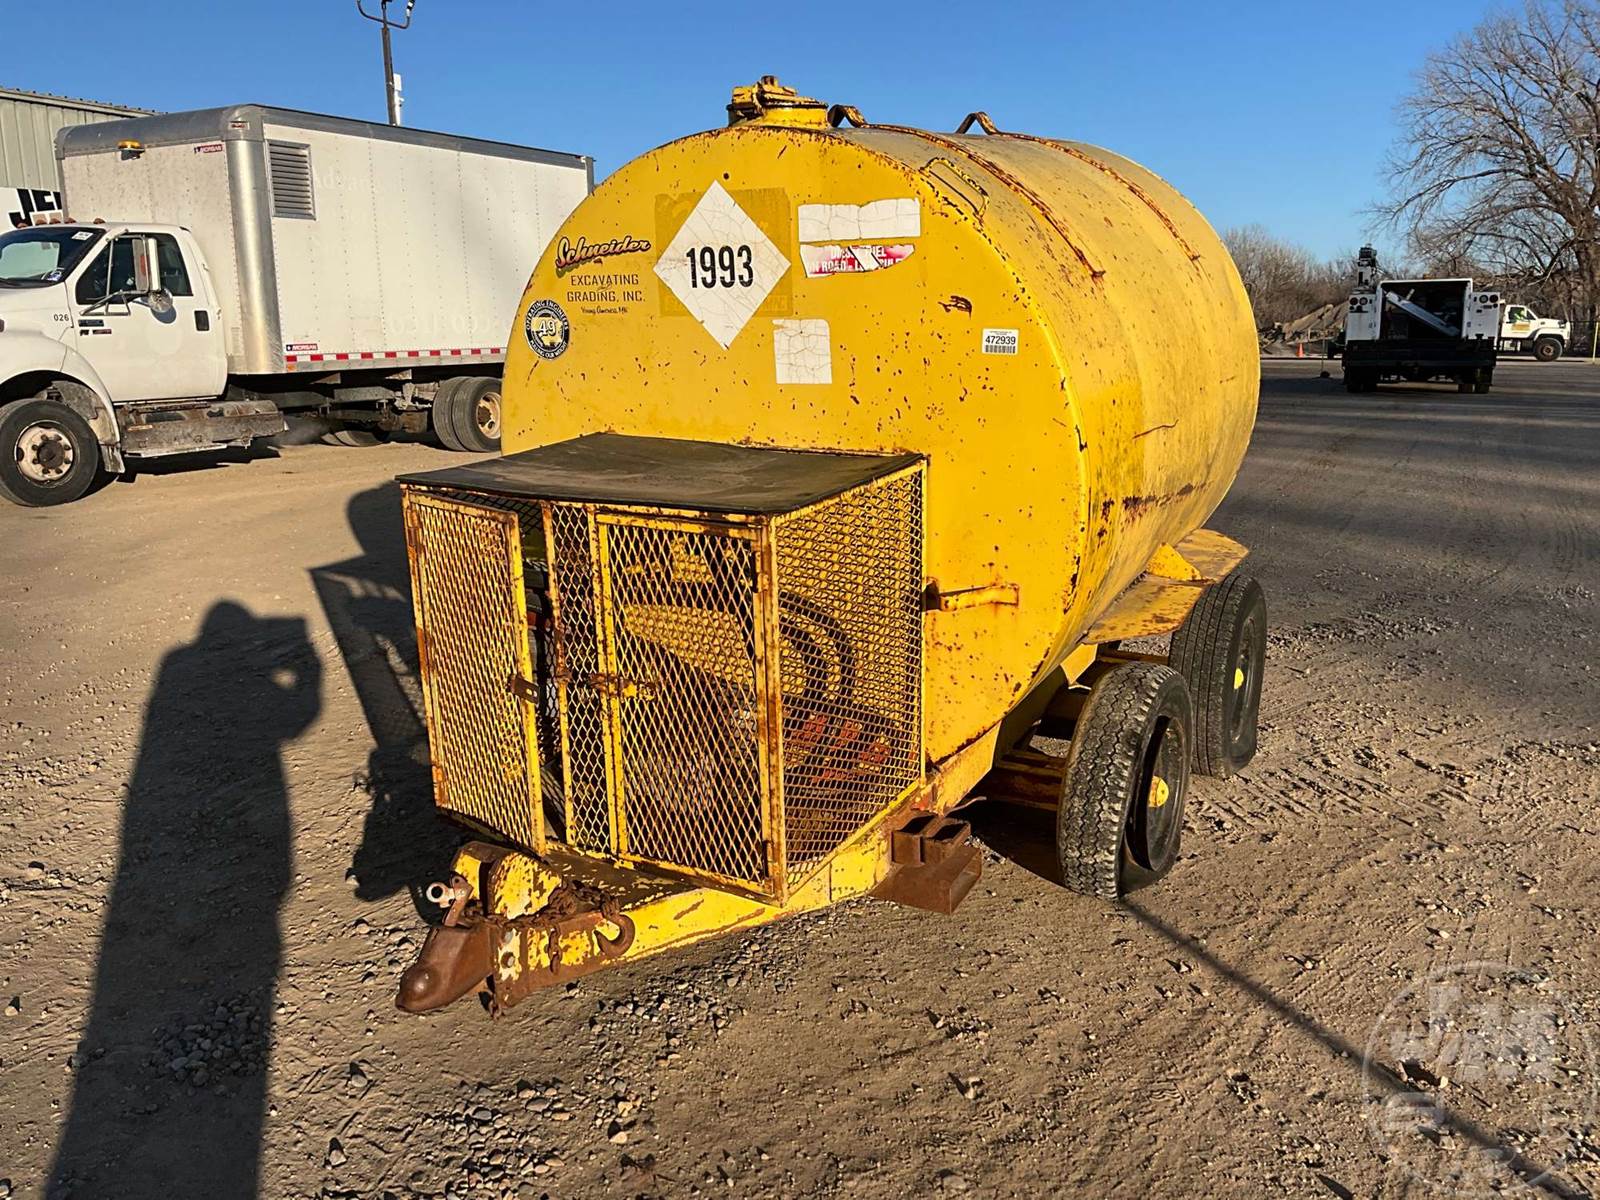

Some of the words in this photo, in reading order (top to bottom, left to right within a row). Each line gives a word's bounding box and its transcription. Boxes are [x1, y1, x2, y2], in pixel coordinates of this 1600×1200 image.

[555, 236, 651, 268] Schneider
[686, 245, 753, 288] 1993
[570, 274, 639, 286] EXCAVATING
[567, 291, 619, 303] GRADING,
[623, 291, 646, 302] INC.
[53, 313, 70, 322] 026
[539, 320, 557, 337] 49
[985, 335, 1016, 345] 472939
